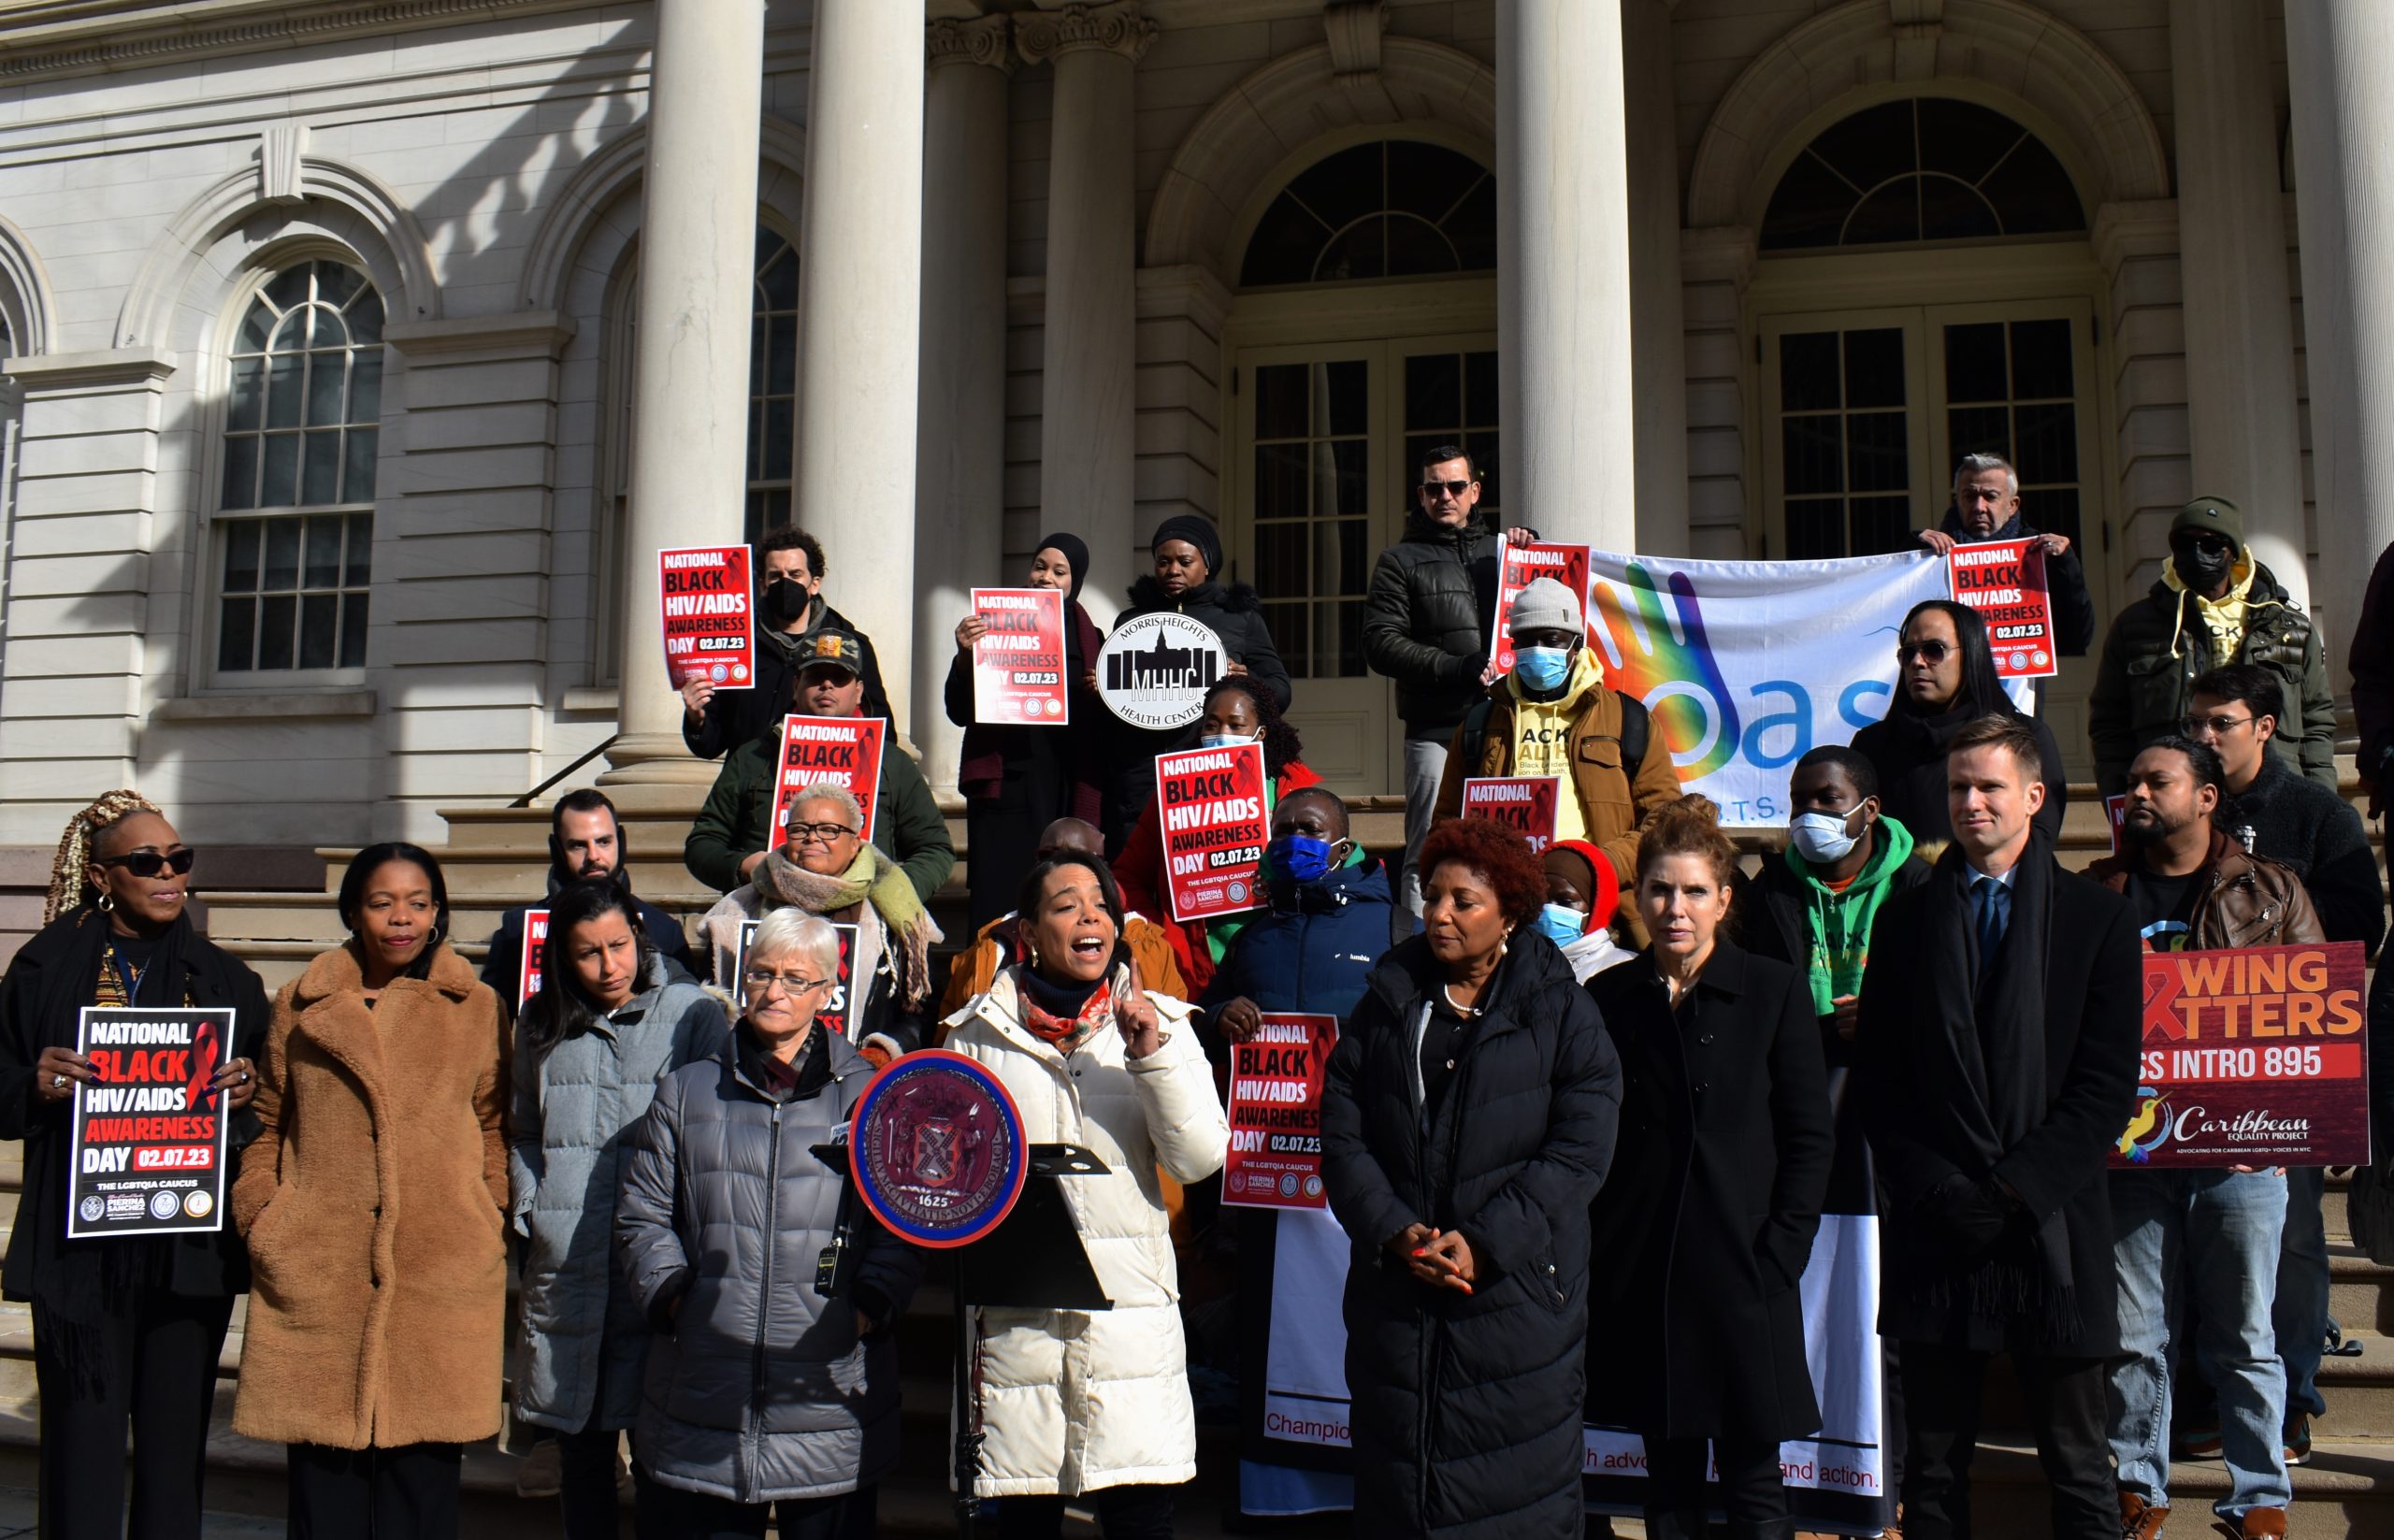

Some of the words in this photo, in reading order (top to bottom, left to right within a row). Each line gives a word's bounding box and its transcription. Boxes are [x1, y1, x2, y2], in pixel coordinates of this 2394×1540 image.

[664, 552, 726, 569] NATIONAL
[1507, 547, 1566, 566] NATIONAL
[1954, 548, 2018, 568] NATIONAL
[665, 569, 725, 593] BLACK
[1956, 565, 2021, 589] BLACK
[666, 593, 746, 617] HIV/AIDS
[978, 596, 1039, 611] NATIONAL
[1957, 588, 2023, 607] HIV/AIDS
[980, 612, 1039, 632] BLACK
[1979, 604, 2044, 623] ARENESS
[667, 617, 745, 635] AWARENESS
[1119, 617, 1161, 641] MORRIS
[1162, 616, 1208, 641] HEIGHTS
[1996, 624, 2044, 639] 02.07.23
[668, 637, 696, 655] DAY
[699, 637, 745, 650] 02.07.23
[980, 635, 1041, 651] HIV/AIDS
[982, 652, 1059, 668] AWARENESS
[1014, 672, 1059, 684] 02.07.23
[1131, 668, 1198, 702] MHHC
[1119, 704, 1161, 725] HEALTH
[1164, 701, 1204, 725] CENTER
[789, 724, 858, 742] NATIONAL
[1521, 727, 1571, 744] ACK
[786, 743, 855, 768] BLACK
[1162, 752, 1234, 777] NATIONAL
[784, 769, 853, 788] HIV/AIDS
[1165, 772, 1235, 804] BLACK
[1469, 784, 1533, 802] NATIONAL
[1167, 797, 1260, 831] HIV/AIDS
[1172, 824, 1262, 853] AWARENESS
[1173, 853, 1204, 876] DAY
[1210, 846, 1261, 867] 02.07.23
[1187, 879, 1201, 887] THE
[1201, 875, 1229, 885] LGBTQIA
[2177, 951, 2328, 997] WING
[2174, 989, 2363, 1040] TTERS
[90, 1021, 192, 1045] NATIONAL
[89, 1049, 190, 1084] BLACK
[1237, 1047, 1308, 1078] BLACK
[2172, 1047, 2256, 1079] INTRO
[2264, 1045, 2322, 1077] 895
[85, 1087, 187, 1114] HIV/AIDS
[1235, 1080, 1307, 1103] HIV/AIDS
[83, 1115, 216, 1144] AWARENESS
[1234, 1106, 1320, 1130] AWARENES
[2173, 1105, 2312, 1142] Caribbean
[1232, 1130, 1266, 1153] DAY
[1271, 1134, 1321, 1153] 02.07.23
[2228, 1131, 2270, 1142] EQUALITY
[2271, 1130, 2308, 1141] PROJECT
[82, 1146, 132, 1173] DAY
[137, 1147, 210, 1168] 02.07.23
[1256, 1162, 1285, 1171] LGBTQIA
[96, 1182, 117, 1191] THE
[117, 1180, 158, 1190] LGBTQIA
[159, 1179, 198, 1188] CAUCUS
[107, 1197, 146, 1206] PIERINA
[107, 1203, 146, 1213] SANCHEZ
[917, 1194, 949, 1208] 1625
[1266, 1413, 1350, 1442] Champio
[1779, 1461, 1813, 1481] and
[1819, 1464, 1880, 1489] action.
